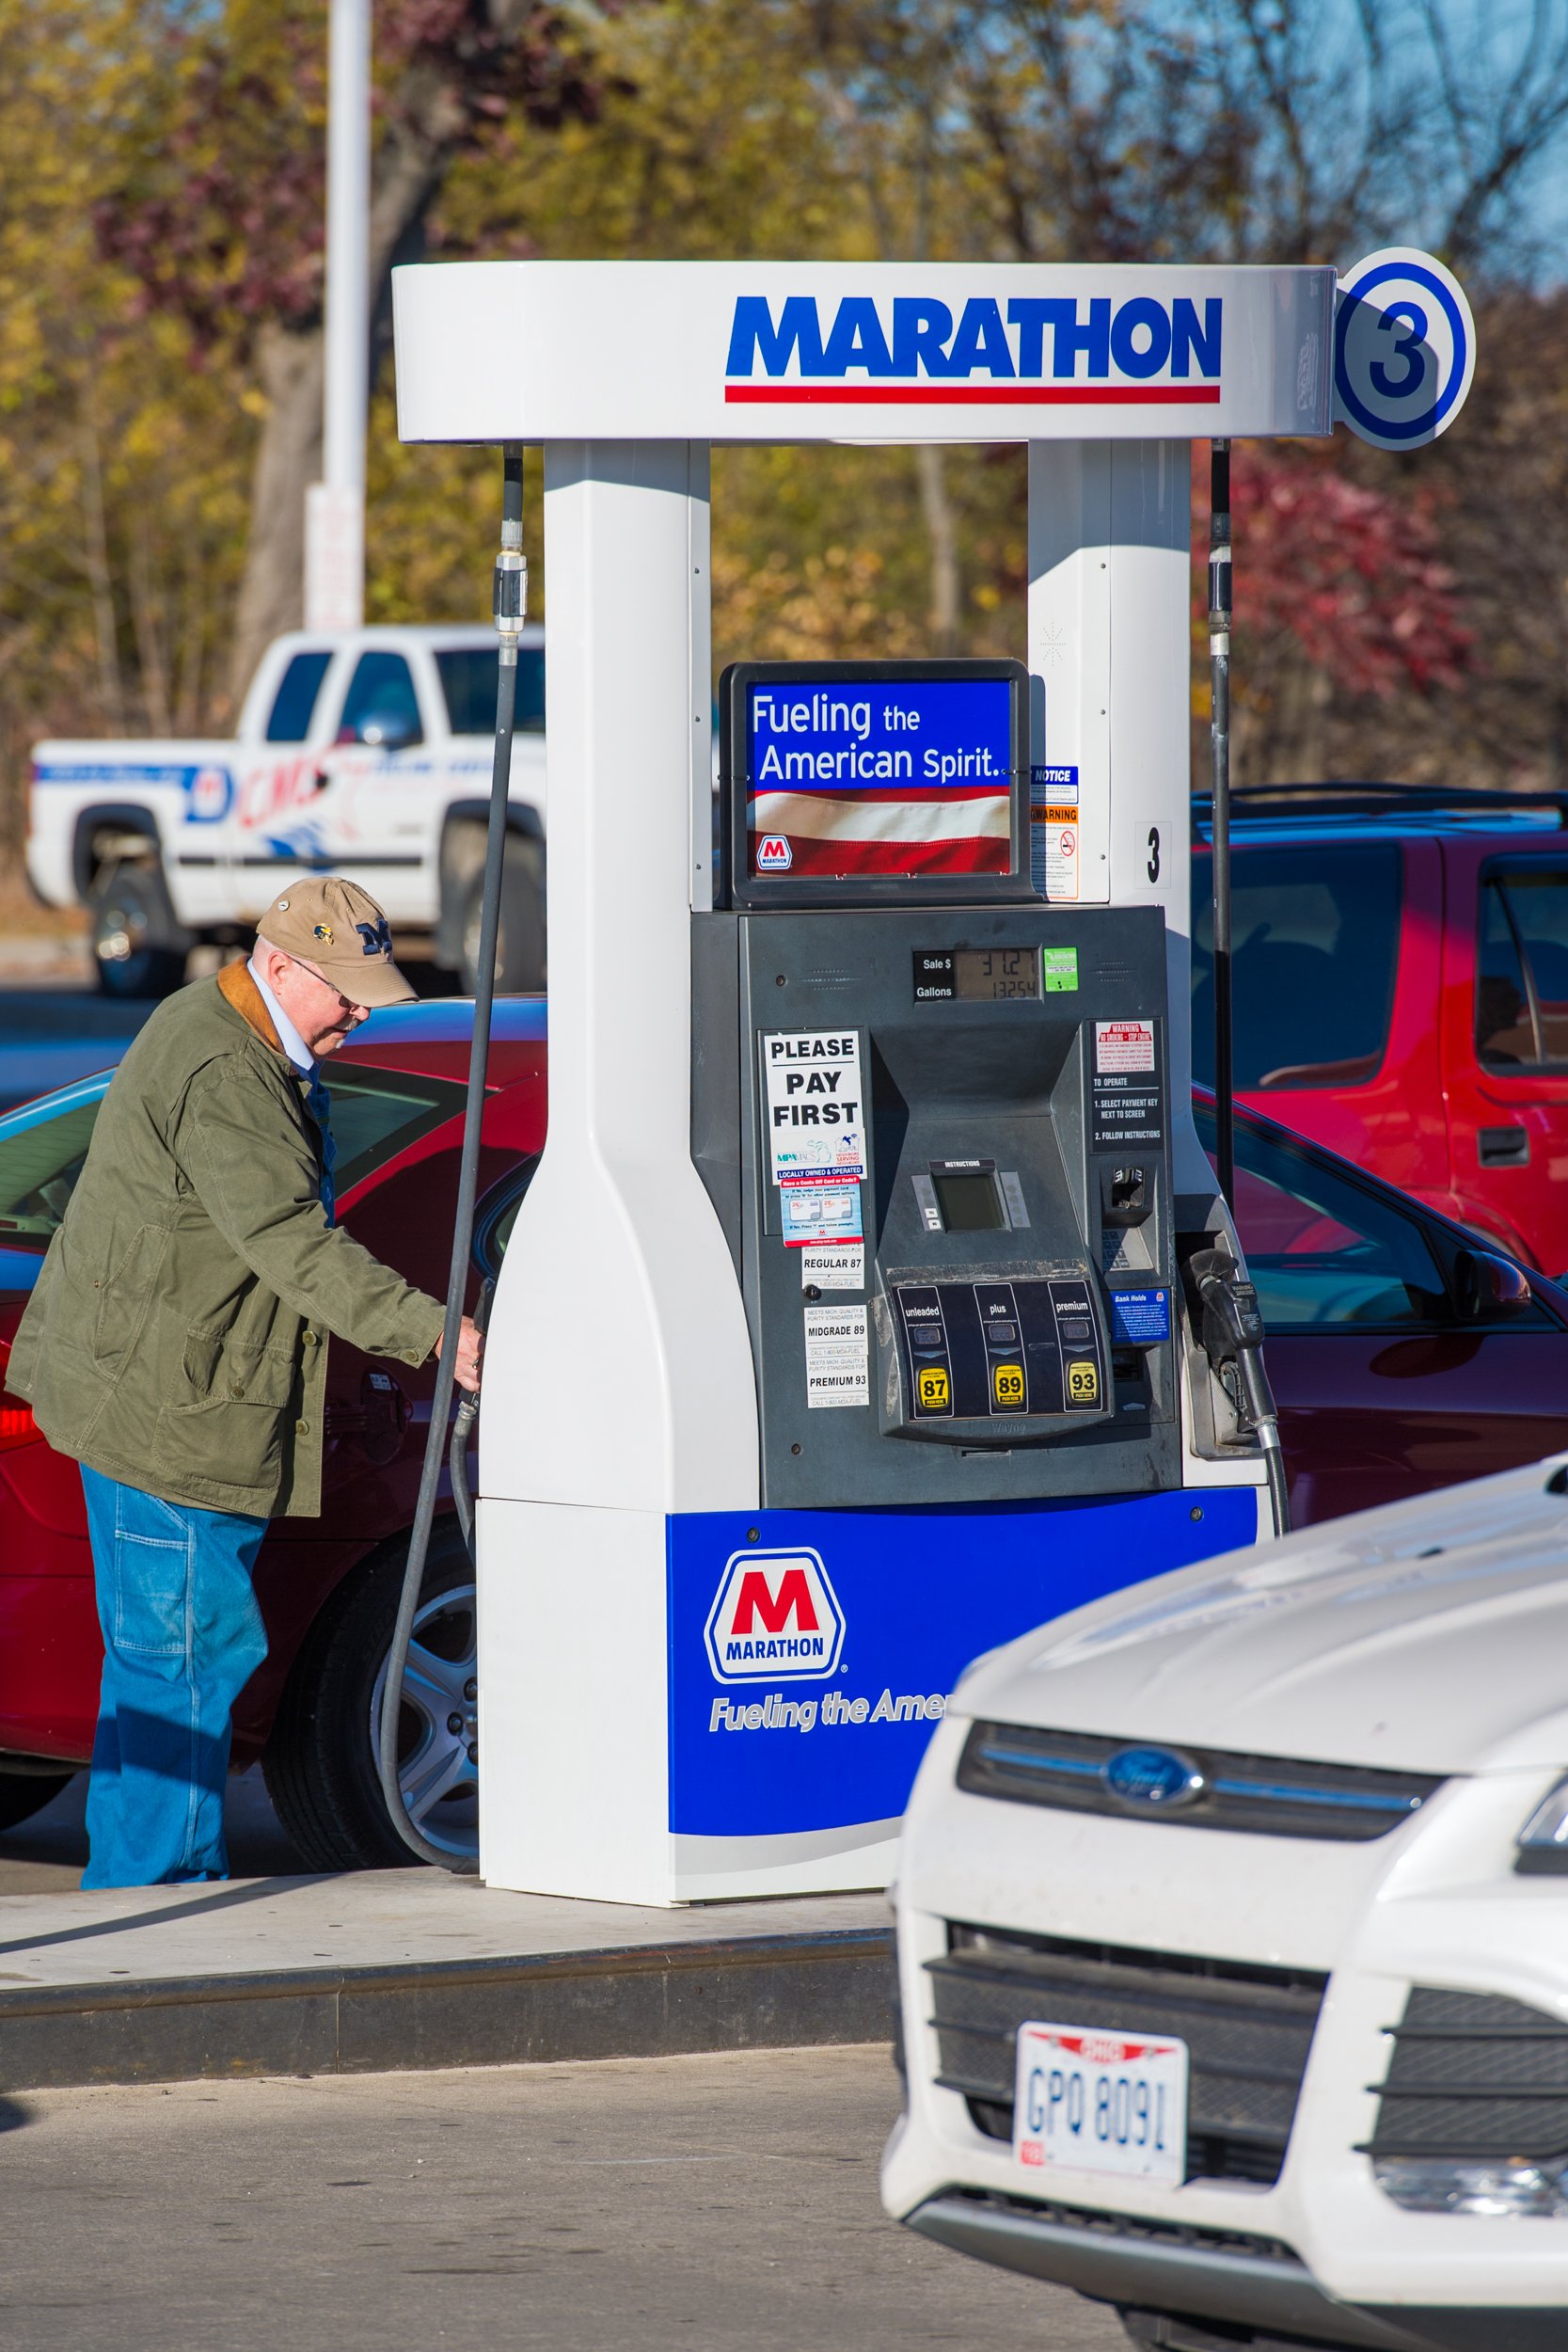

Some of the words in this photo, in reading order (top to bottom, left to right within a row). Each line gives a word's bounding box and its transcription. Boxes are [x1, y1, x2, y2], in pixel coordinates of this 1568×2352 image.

[725, 295, 1223, 378] MARATHON
[1370, 300, 1428, 398] 3
[753, 695, 871, 740] Fueling
[883, 706, 920, 731] the
[760, 745, 912, 780] American
[924, 748, 1000, 785] Spirit.
[1035, 770, 1070, 782] NOTICE
[1037, 809, 1077, 820] WARNING
[764, 841, 785, 857] M
[1148, 827, 1160, 883] 3
[356, 917, 393, 956] M
[924, 959, 942, 969] Sale
[945, 959, 951, 969] $
[917, 987, 952, 996] Gallons
[1138, 1032, 1150, 1041] ENGINE
[771, 1039, 854, 1058] PLEASE
[786, 1072, 841, 1094] PAY
[1122, 1099, 1147, 1107] PAYMENT
[773, 1102, 858, 1126] FIRST
[1101, 1111, 1116, 1120] NEXT
[1125, 1109, 1145, 1119] SCREEN
[1095, 1132, 1101, 1140] 2.
[1125, 1130, 1160, 1138] INSTRUCTIONS
[779, 1170, 804, 1179] LOCALLY
[804, 1259, 847, 1268] REGULAR
[850, 1259, 862, 1267] 87
[906, 1306, 940, 1317] unleaded
[990, 1304, 1006, 1315] plus
[1056, 1301, 1088, 1312] premium
[808, 1326, 851, 1337] MIDGRADE
[854, 1325, 864, 1335] 89
[810, 1376, 853, 1387] PREMIUM
[855, 1375, 866, 1385] 93
[924, 1379, 945, 1397] 87
[999, 1377, 1021, 1393] 89
[1072, 1374, 1094, 1391] 93
[991, 1422, 1026, 1434] Wayne
[731, 1568, 819, 1635] M
[726, 1637, 824, 1661] MARATHON
[709, 1693, 818, 1732] Fueling
[820, 1691, 868, 1724] the
[1028, 2067, 1085, 2136] GPQ
[1095, 2076, 1166, 2151] 8091
